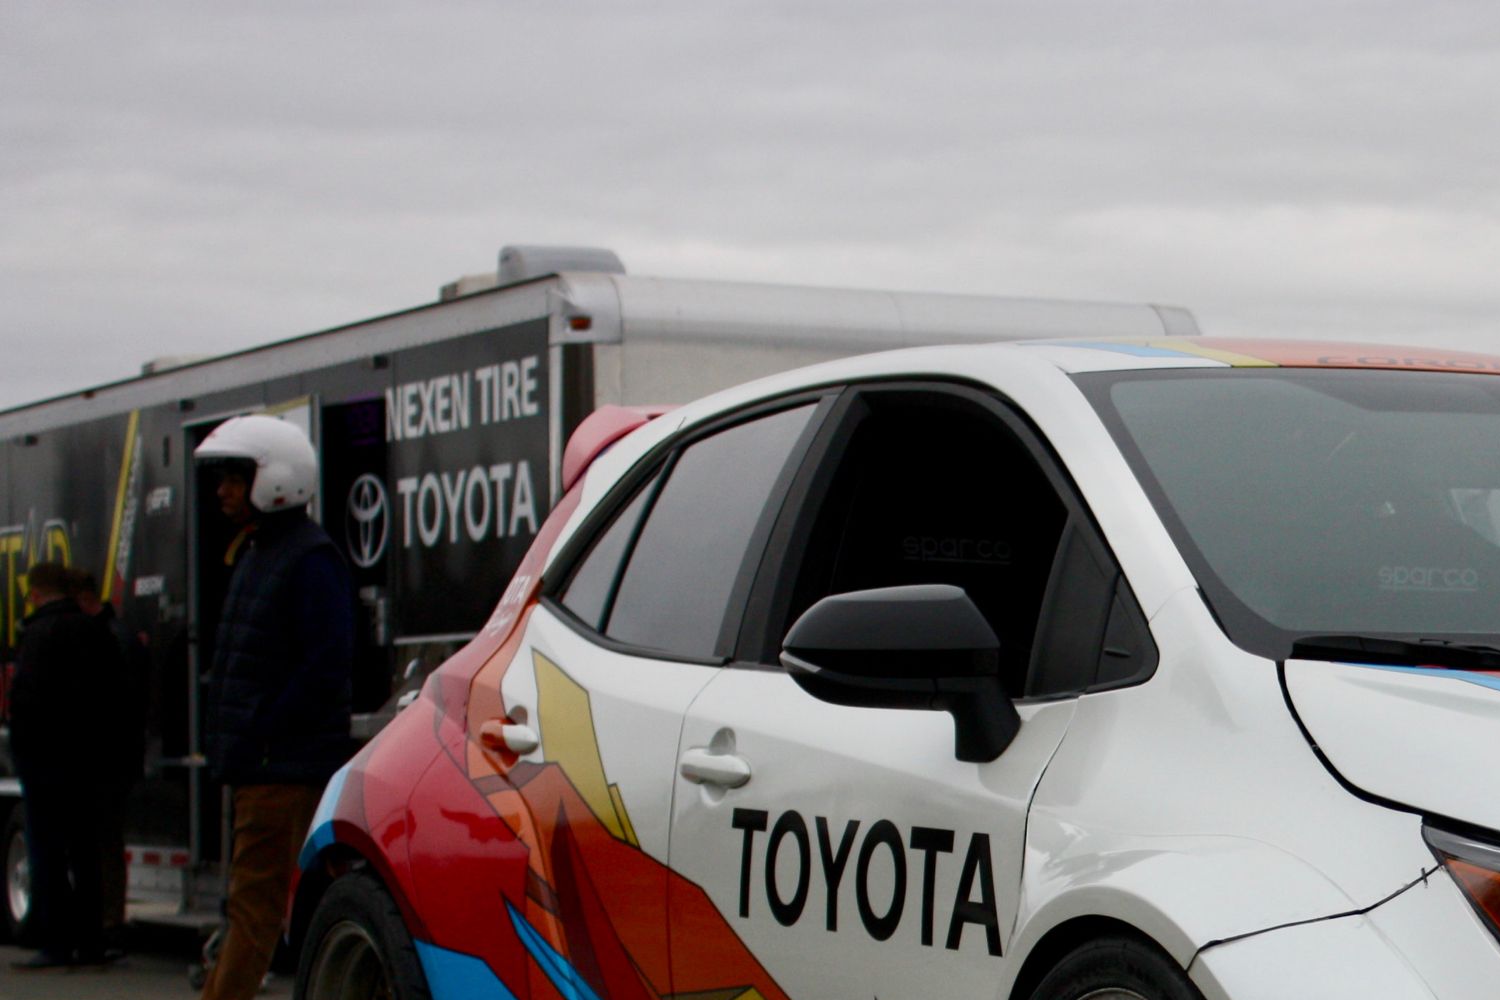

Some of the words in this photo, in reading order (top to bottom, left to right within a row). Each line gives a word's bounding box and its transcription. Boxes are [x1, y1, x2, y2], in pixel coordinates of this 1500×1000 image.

[385, 371, 471, 442] NEXEN
[475, 356, 539, 425] TIRE
[397, 460, 538, 547] TOYOTA
[732, 807, 1003, 957] TOYOTA
